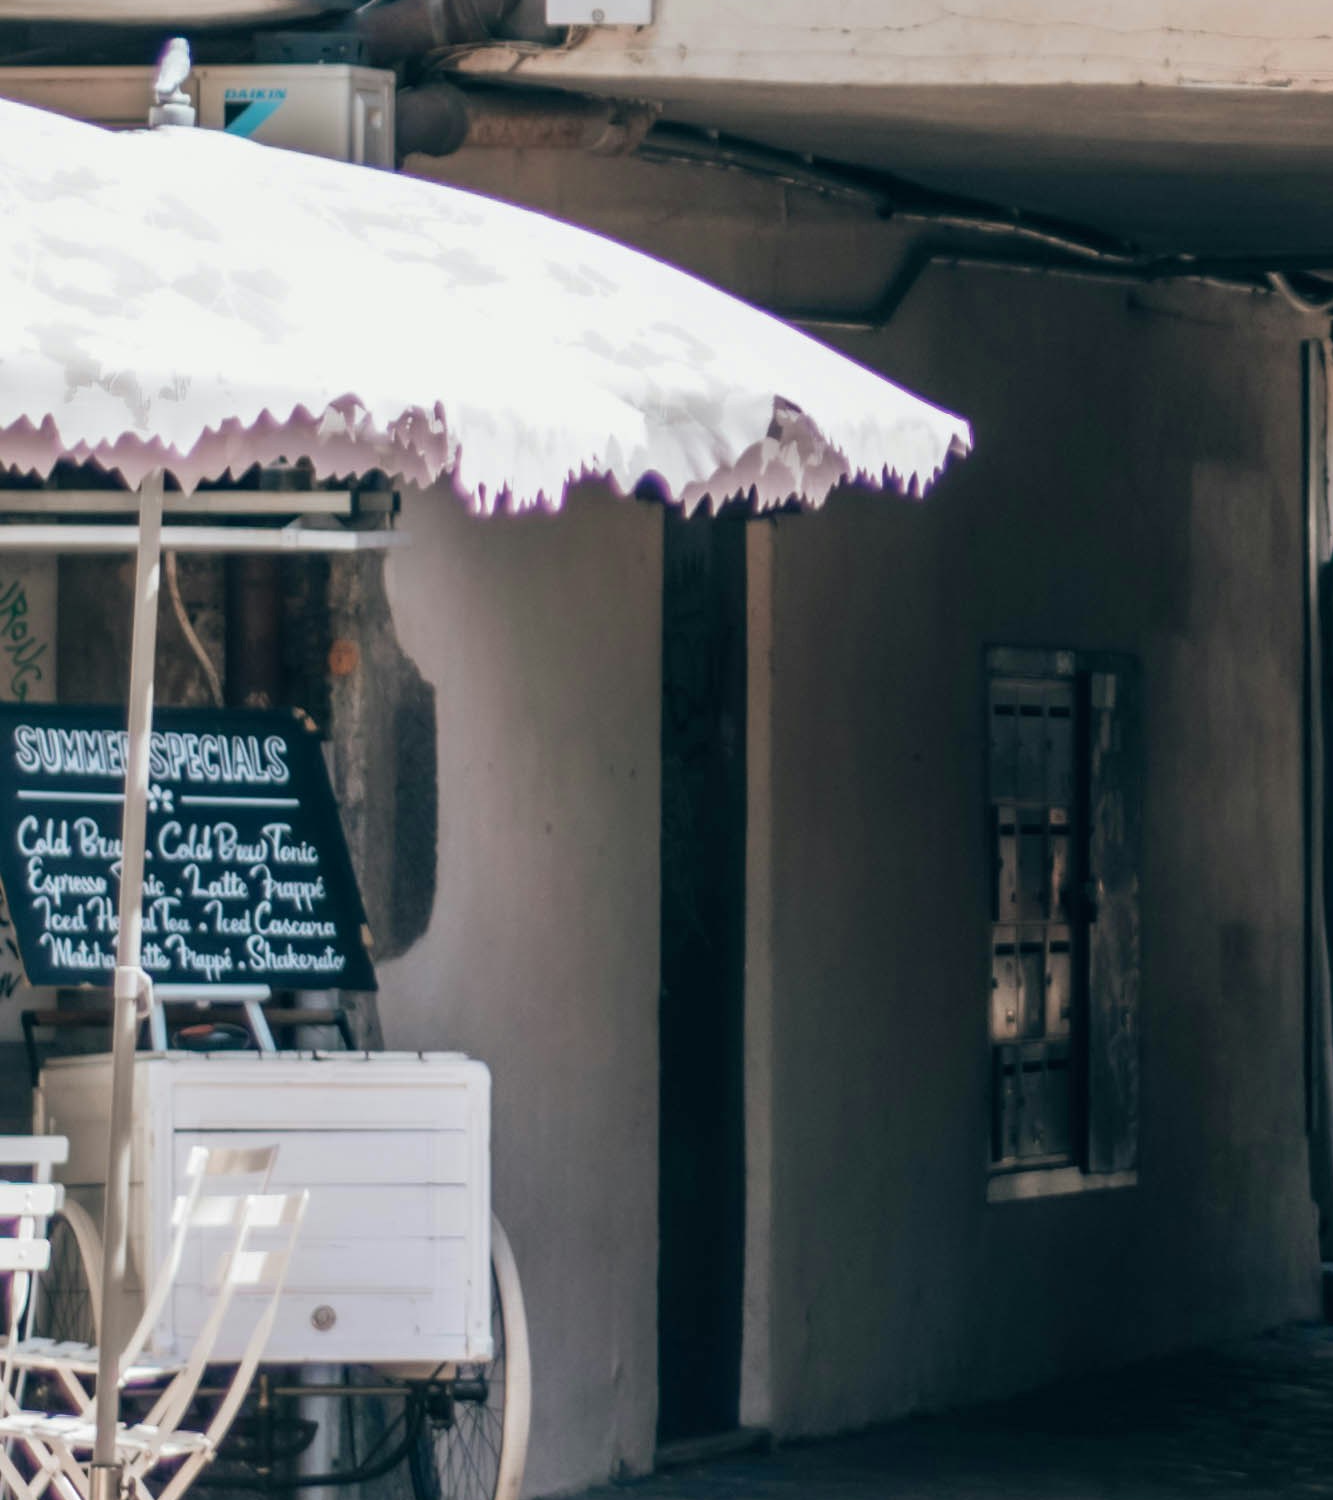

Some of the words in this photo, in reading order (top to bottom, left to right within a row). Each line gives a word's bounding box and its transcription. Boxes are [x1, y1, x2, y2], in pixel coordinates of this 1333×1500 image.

[224, 87, 287, 99] DAIKIN
[148, 731, 290, 784] SPECIALS
[17, 815, 71, 857] Cold
[158, 820, 213, 861] Cold
[213, 822, 267, 862] Brew
[261, 822, 319, 863] Tonic
[28, 856, 107, 904] Espresso
[183, 863, 249, 898] Latte
[250, 863, 326, 912] Frappé
[33, 896, 87, 931] Iced
[87, 896, 157, 932] Heal
[152, 896, 191, 933] Tea
[203, 899, 250, 934] Iced
[254, 900, 335, 937] Cascara
[39, 932, 117, 969] Matcha
[112, 933, 172, 970] atte
[246, 934, 345, 972] Shakerato
